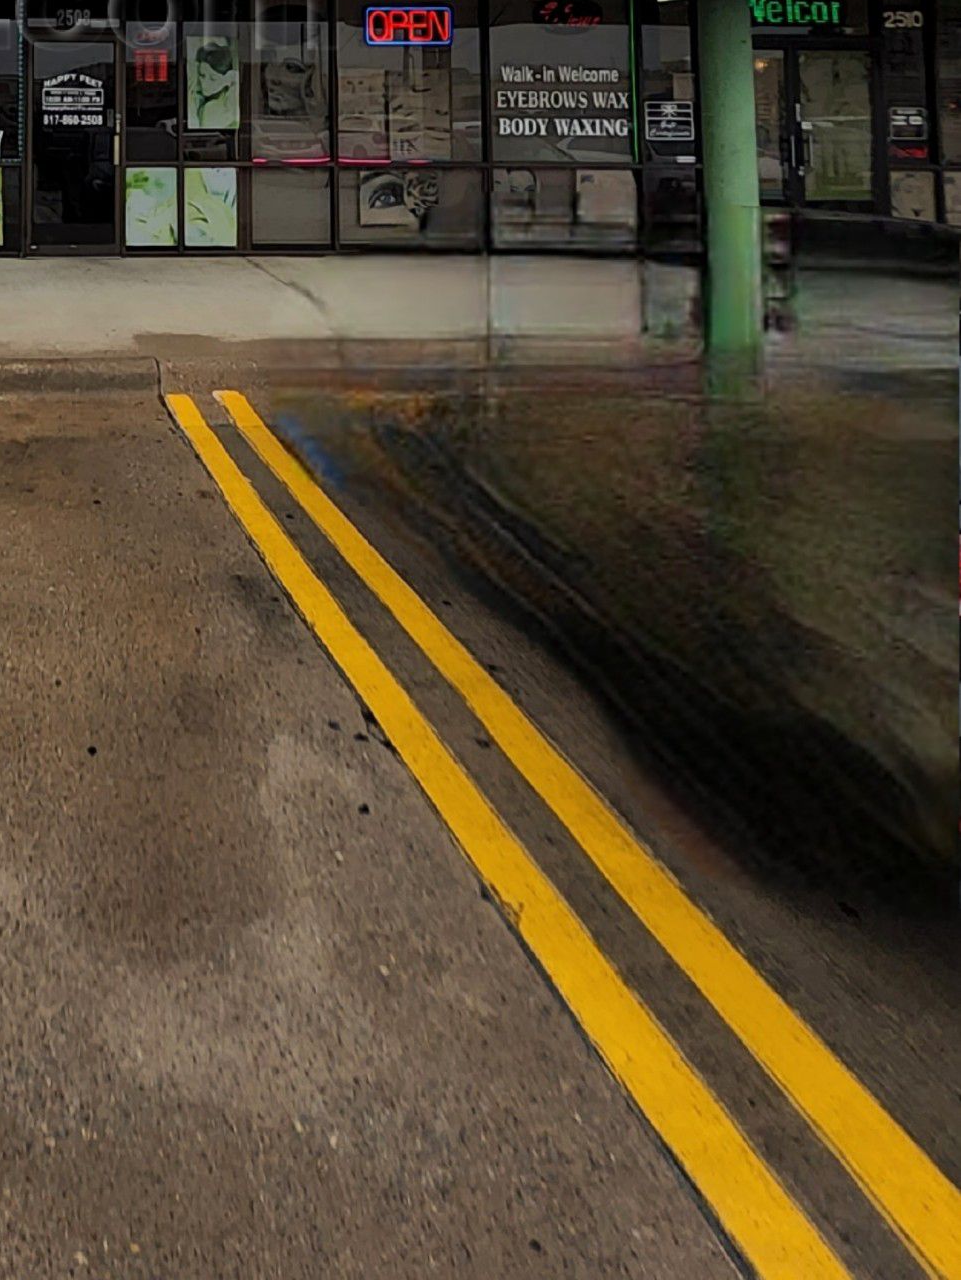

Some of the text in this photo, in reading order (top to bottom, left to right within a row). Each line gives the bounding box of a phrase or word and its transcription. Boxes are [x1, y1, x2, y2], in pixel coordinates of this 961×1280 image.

[56, 9, 91, 26] 2508
[368, 10, 450, 41] OPEN
[883, 11, 924, 28] 2510
[43, 73, 103, 88] HAPPY FEET
[558, 65, 619, 83] Welcome
[496, 90, 629, 109] EYEBROWS WAX
[498, 118, 549, 136] BODY
[553, 118, 629, 137] WAXING
